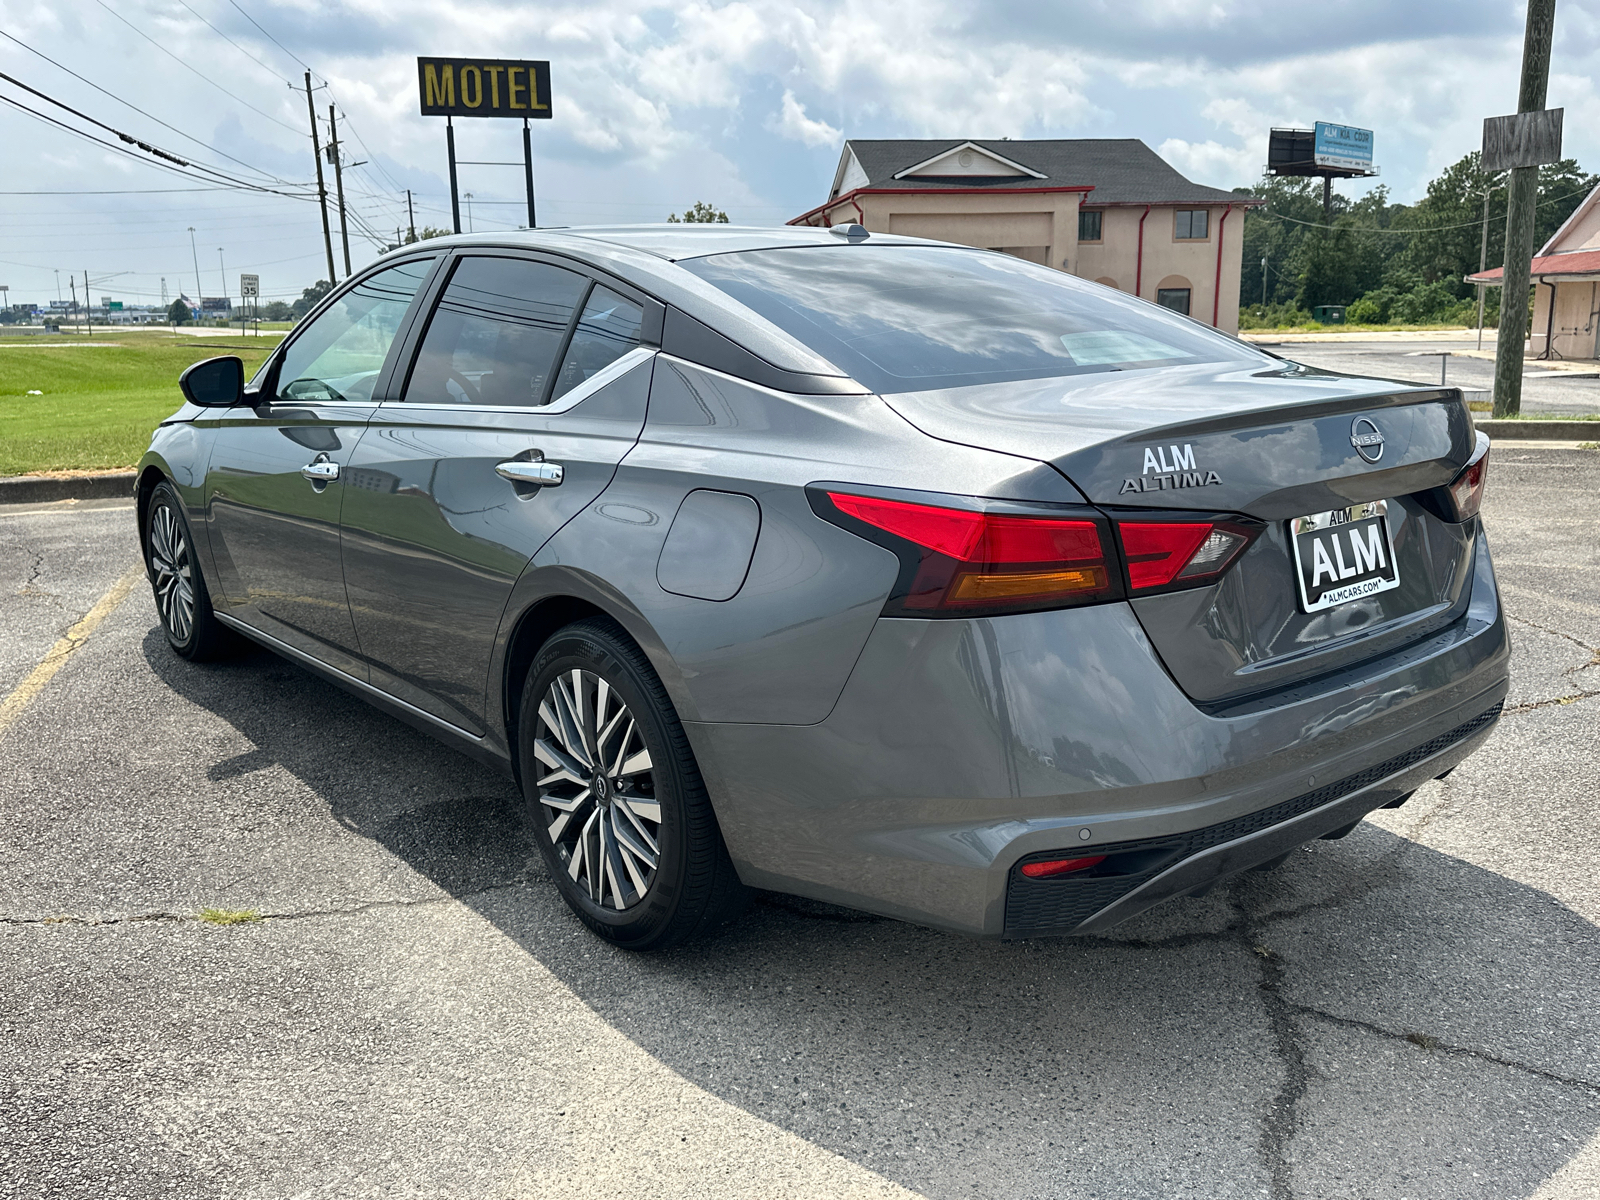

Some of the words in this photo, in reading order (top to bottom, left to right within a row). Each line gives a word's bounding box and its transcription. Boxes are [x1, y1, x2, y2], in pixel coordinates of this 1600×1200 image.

[424, 63, 548, 110] MOTEL
[1324, 126, 1337, 138] ALM
[1340, 129, 1350, 141] KIA
[244, 287, 257, 295] 35
[1142, 443, 1197, 475] ALM
[1118, 470, 1224, 495] ALTIMA
[1329, 507, 1353, 526] ALM
[1312, 523, 1387, 588] ALM
[1328, 580, 1380, 604] ALMCARS.COM
